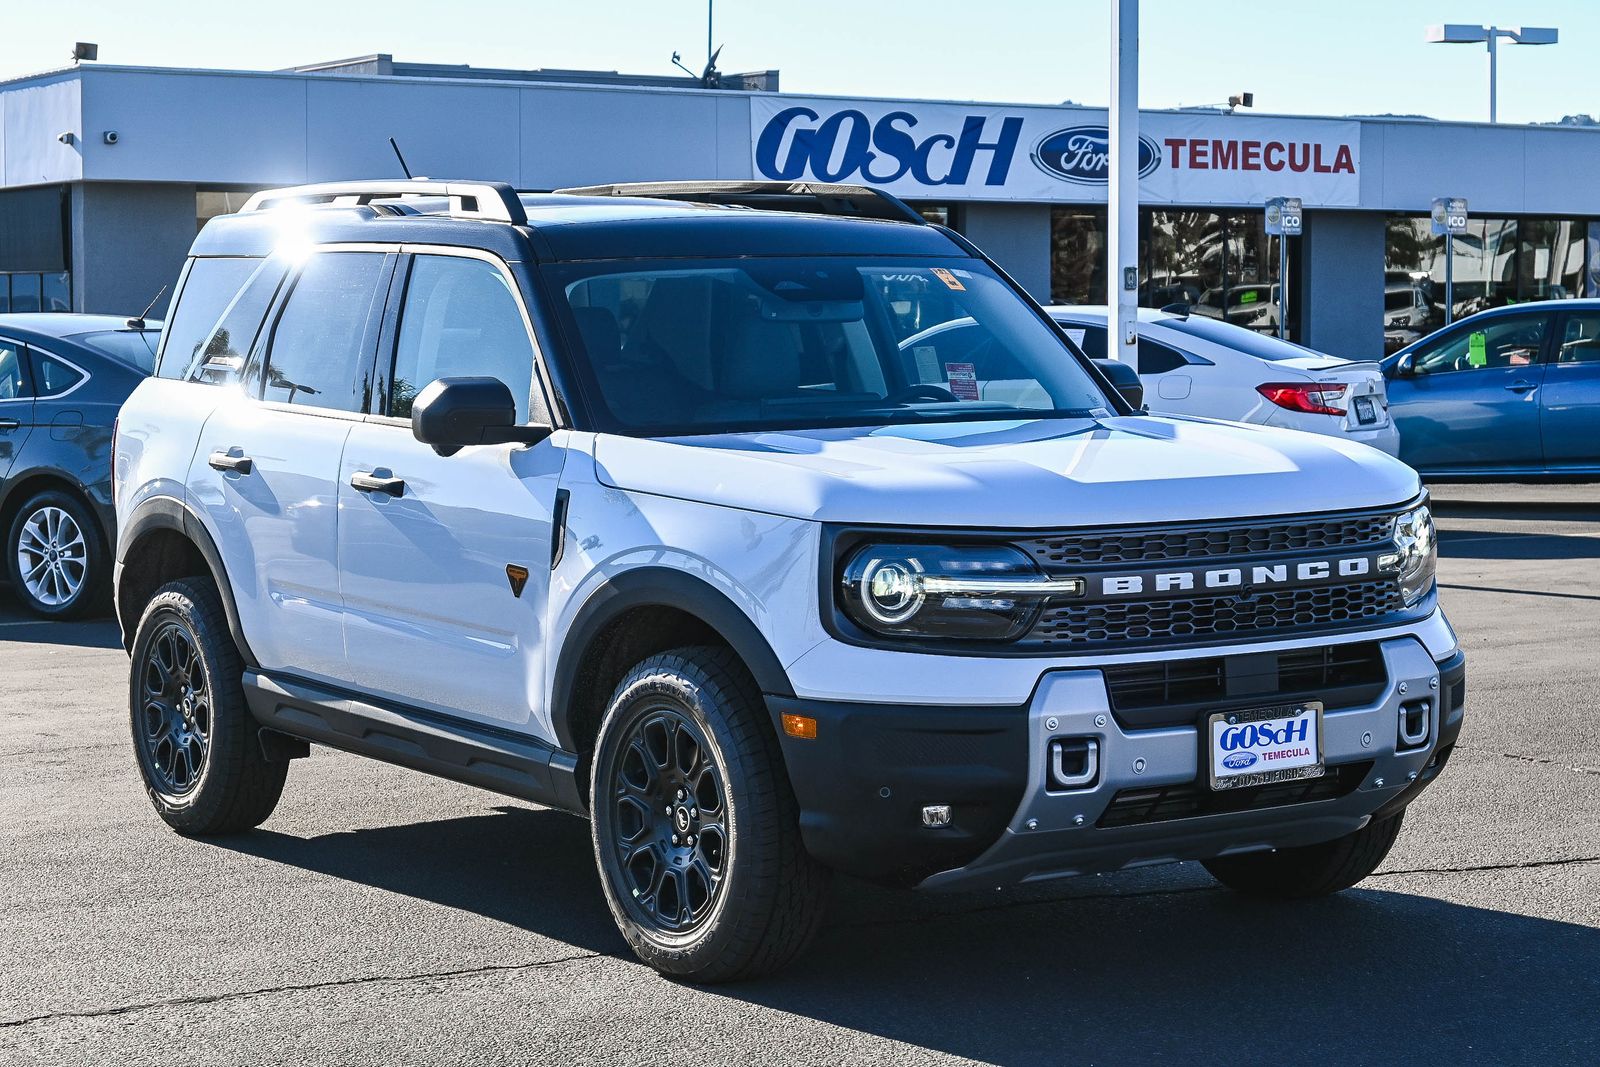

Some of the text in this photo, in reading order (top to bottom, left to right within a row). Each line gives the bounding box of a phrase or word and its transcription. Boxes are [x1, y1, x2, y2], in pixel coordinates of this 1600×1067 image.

[756, 106, 1355, 186] GOSCH For TEMECULA
[1282, 215, 1300, 227] ICO
[1448, 215, 1466, 228] ICO
[1102, 557, 1369, 595] BRONCO
[1235, 708, 1295, 723] TEMECULA
[1219, 718, 1309, 751] GOSCH
[1227, 747, 1311, 768] Ford TEMECULA
